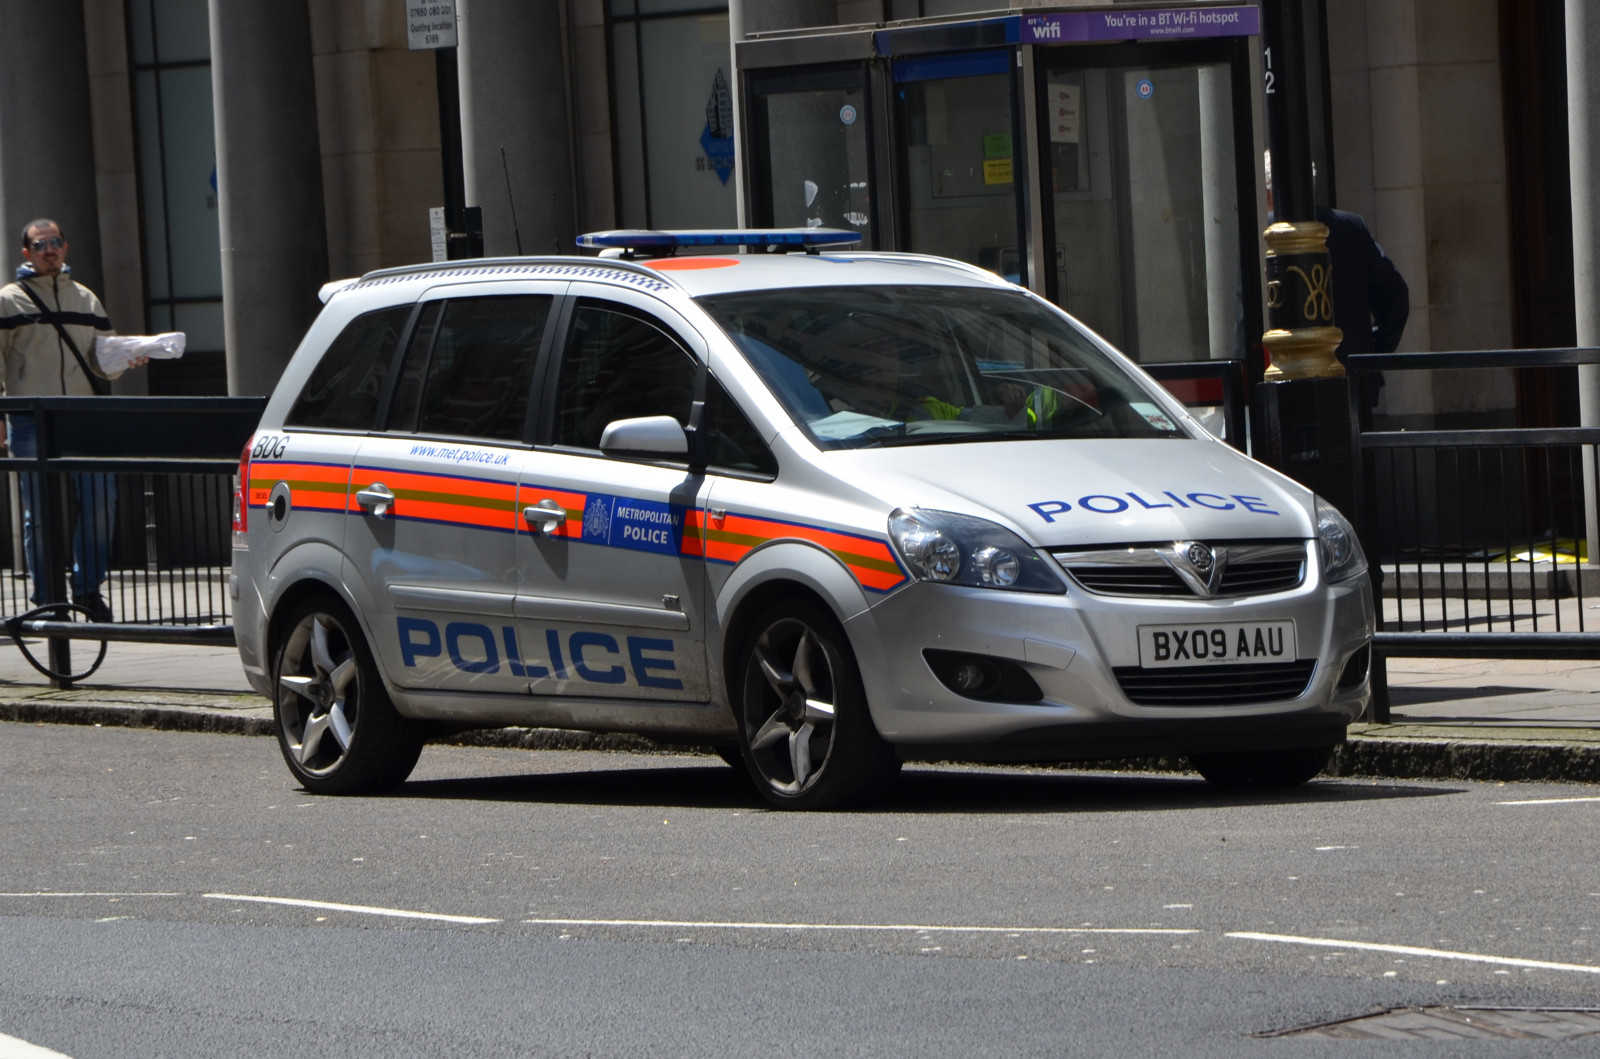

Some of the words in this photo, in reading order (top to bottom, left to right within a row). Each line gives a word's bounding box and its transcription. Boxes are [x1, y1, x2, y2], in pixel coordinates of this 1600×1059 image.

[432, 21, 453, 31] location
[1104, 14, 1136, 27] You're
[1138, 14, 1148, 26] in
[1149, 17, 1156, 25] a
[1158, 13, 1171, 25] BT
[1172, 12, 1197, 24] Wi-fi
[1199, 11, 1239, 25] hotspot
[1033, 21, 1061, 38] wifi
[1150, 26, 1195, 34] www.btwifi.com
[252, 435, 289, 460] BDG
[409, 443, 511, 466] www.met.police.uk
[616, 506, 679, 526] METROPOLITAN
[1026, 491, 1281, 523] POLICE
[623, 525, 668, 544] POLICE
[396, 616, 684, 690] POLICE
[1152, 628, 1227, 662] BX09
[1236, 626, 1284, 658] AAU
